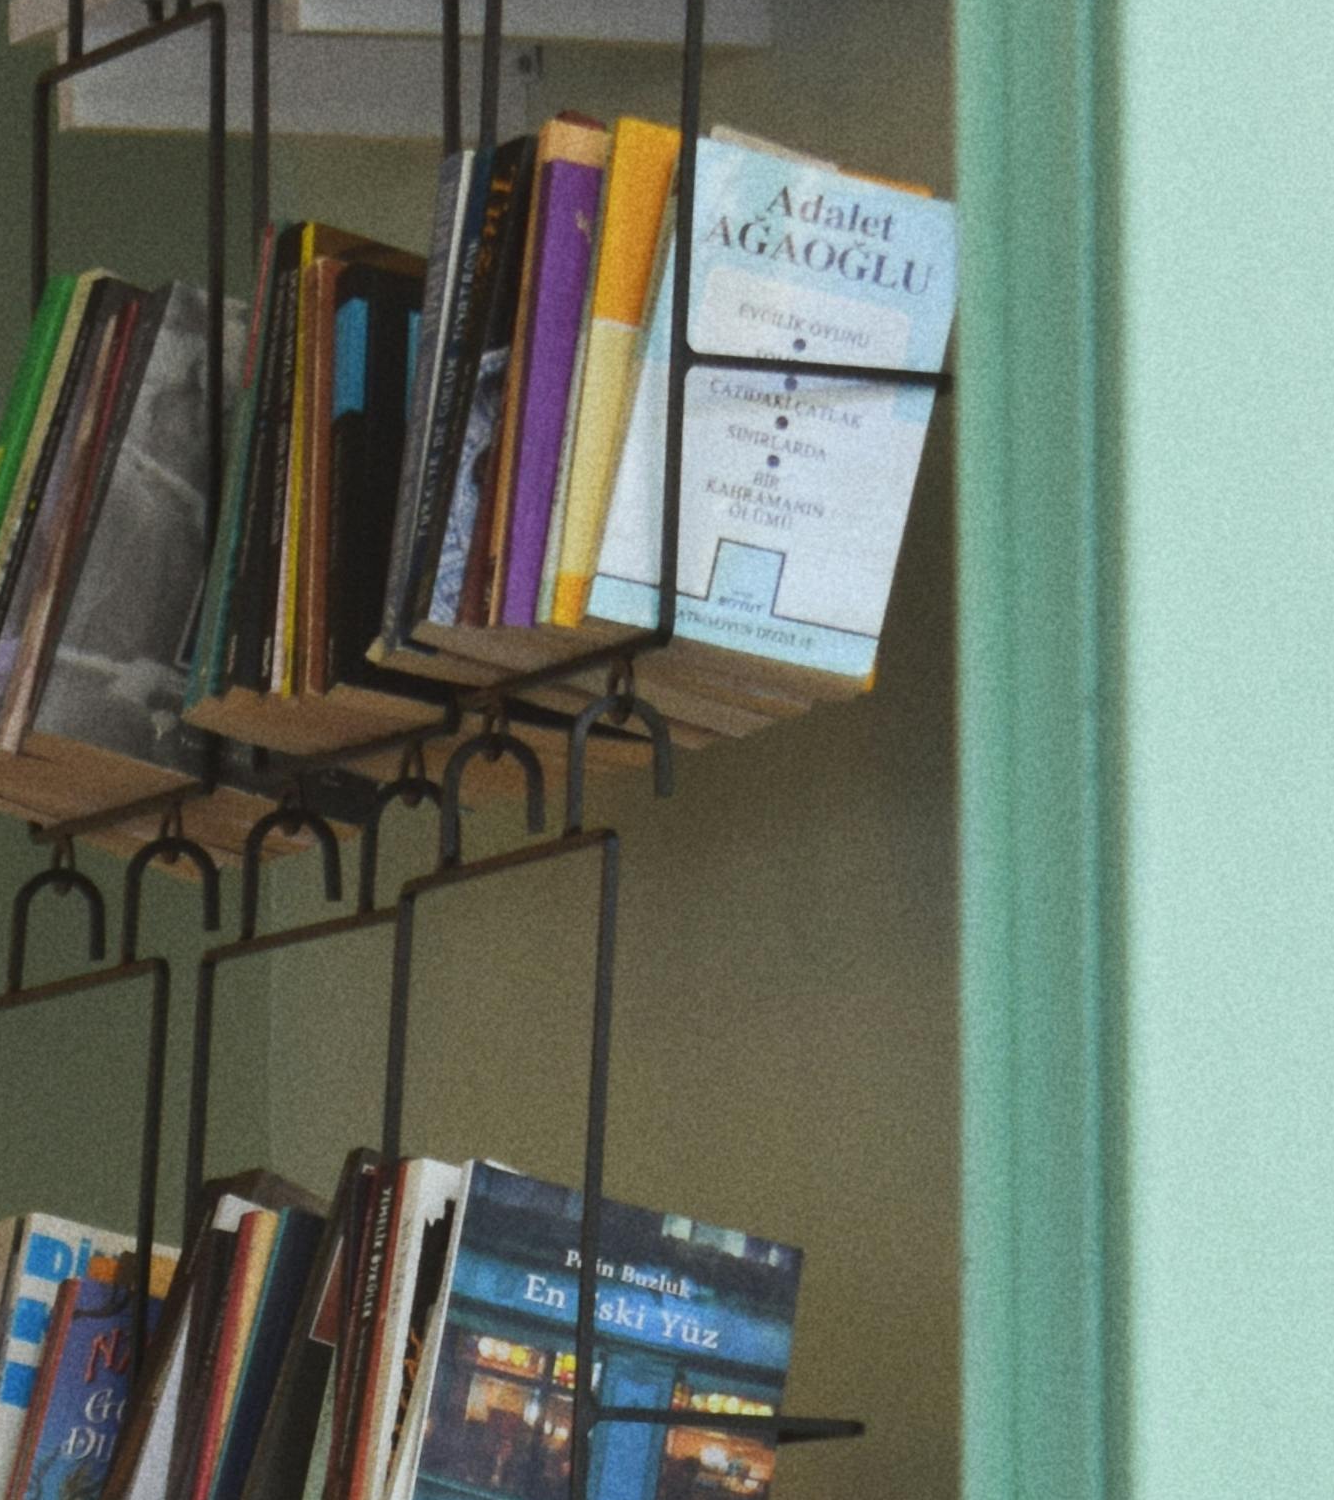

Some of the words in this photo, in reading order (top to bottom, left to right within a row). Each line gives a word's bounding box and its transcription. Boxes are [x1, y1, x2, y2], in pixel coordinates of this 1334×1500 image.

[767, 185, 896, 242] Adalet
[701, 214, 935, 296] AĞAOĞLU
[565, 1249, 615, 1278] Pin
[620, 1264, 691, 1299] Buzluk
[523, 1273, 567, 1309] En
[592, 1291, 647, 1331] ski
[660, 1309, 720, 1350] Yüz
